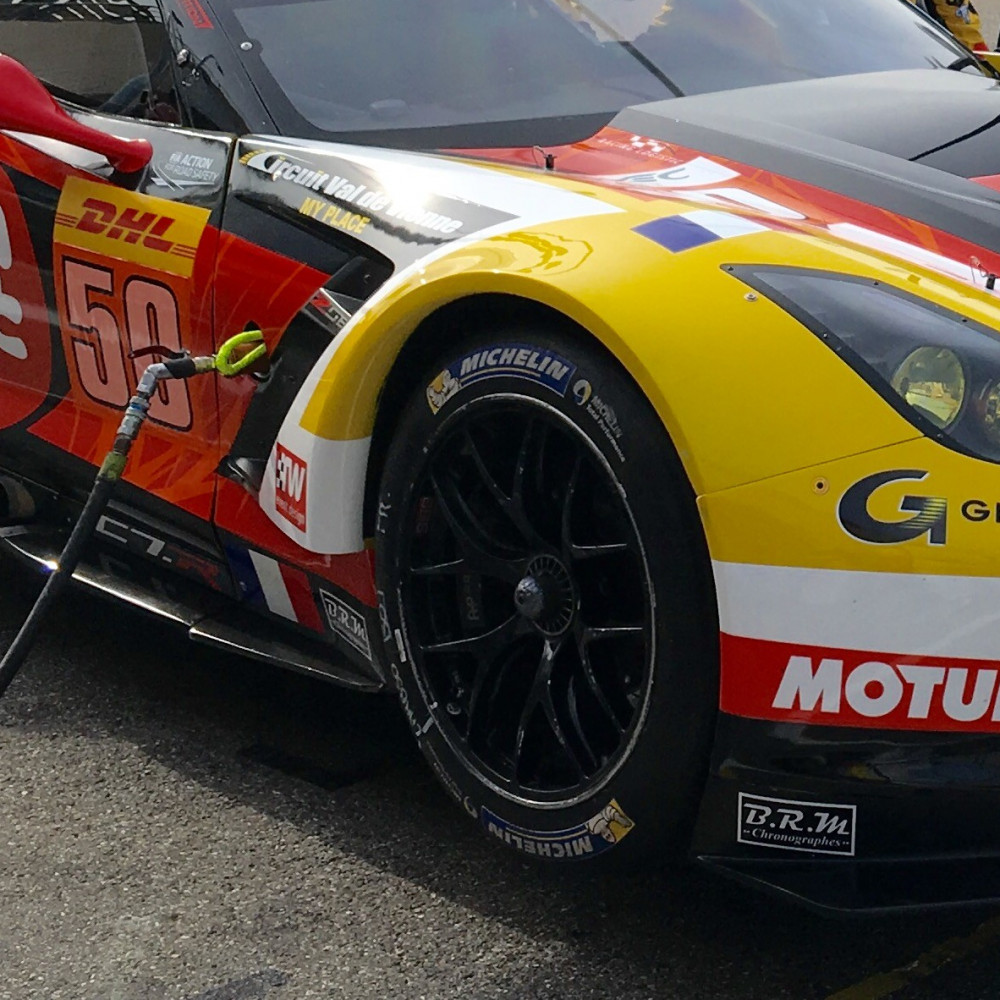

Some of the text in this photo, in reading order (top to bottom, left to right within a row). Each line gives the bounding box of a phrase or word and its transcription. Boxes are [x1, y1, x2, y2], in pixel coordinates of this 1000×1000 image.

[183, 153, 213, 170] ACTION
[244, 151, 325, 191] Circuit
[323, 175, 365, 206] Val
[361, 190, 392, 212] de
[74, 197, 175, 252] DHL
[300, 196, 371, 234] MY PLACE
[62, 255, 193, 432] 50
[460, 349, 569, 382] MICHELIN
[488, 821, 594, 858] MICHELIN
[751, 828, 841, 848] Chronographes
